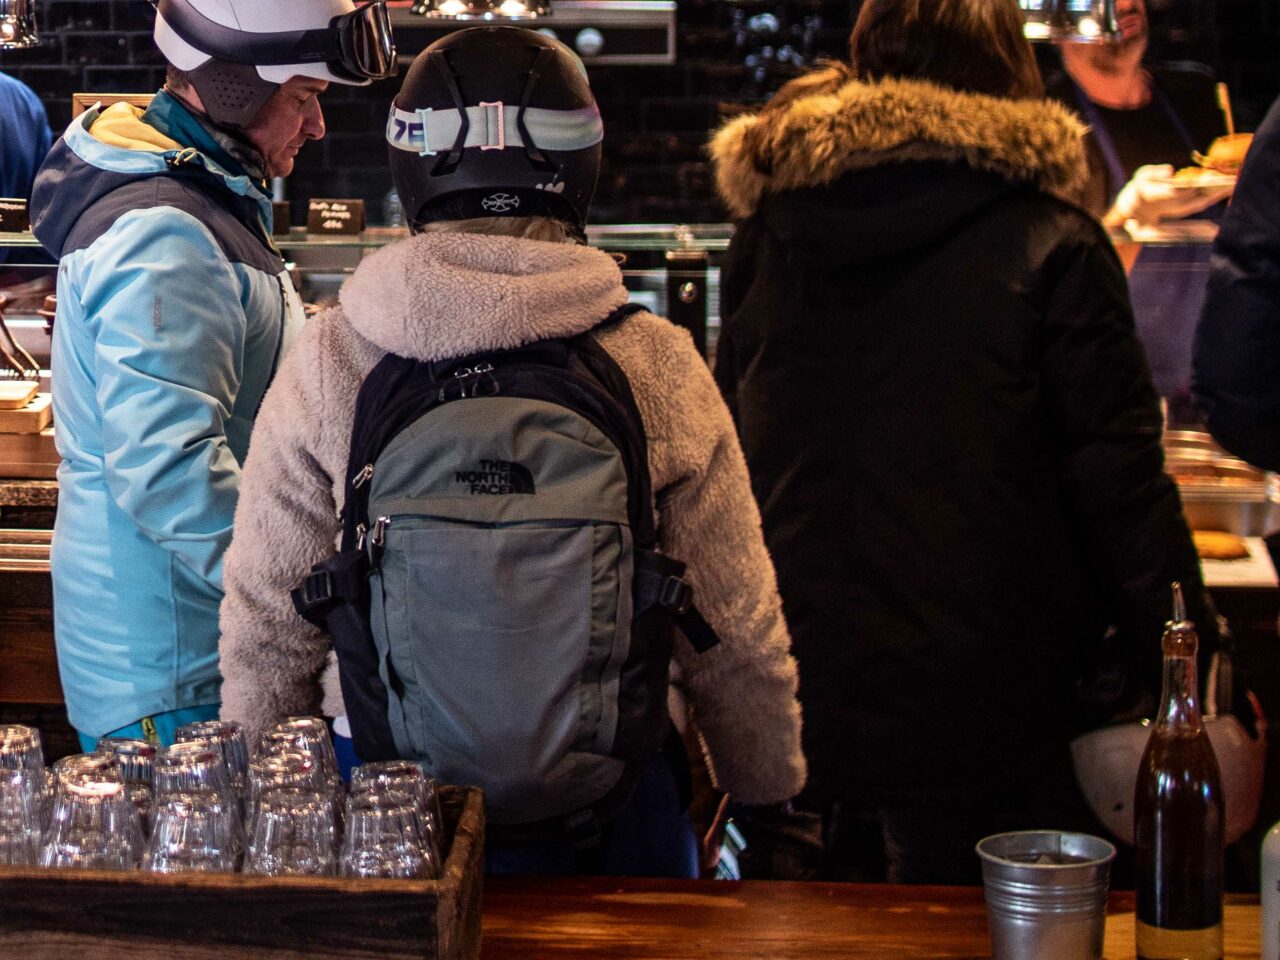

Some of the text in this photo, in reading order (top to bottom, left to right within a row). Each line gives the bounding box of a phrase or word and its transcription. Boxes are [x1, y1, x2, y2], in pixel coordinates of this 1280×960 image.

[480, 460, 509, 472] THE
[455, 471, 508, 484] NORTH
[471, 484, 510, 495] FACE
